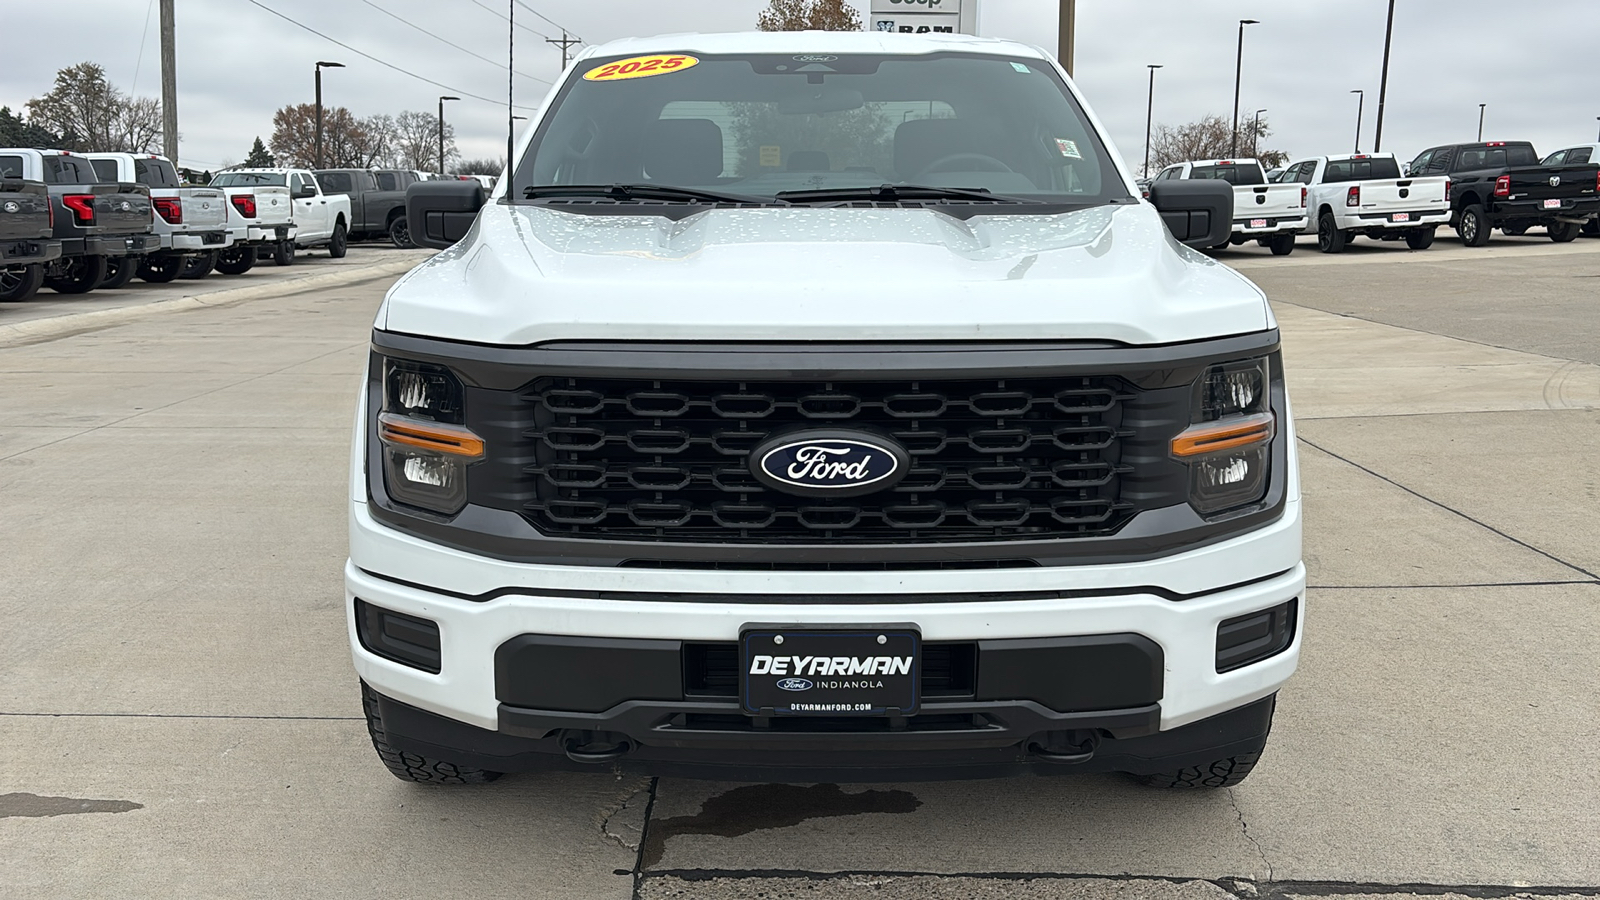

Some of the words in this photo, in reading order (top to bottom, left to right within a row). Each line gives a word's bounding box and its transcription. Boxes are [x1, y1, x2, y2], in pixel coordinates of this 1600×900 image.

[899, 25, 953, 33] RAM
[594, 57, 686, 79] 2025
[787, 446, 872, 479] Ford
[750, 655, 913, 676] DEYARMAN
[783, 679, 807, 689] Ford
[816, 680, 884, 689] INDIANOLA
[790, 703, 872, 711] DEYARMANFORD.COM
